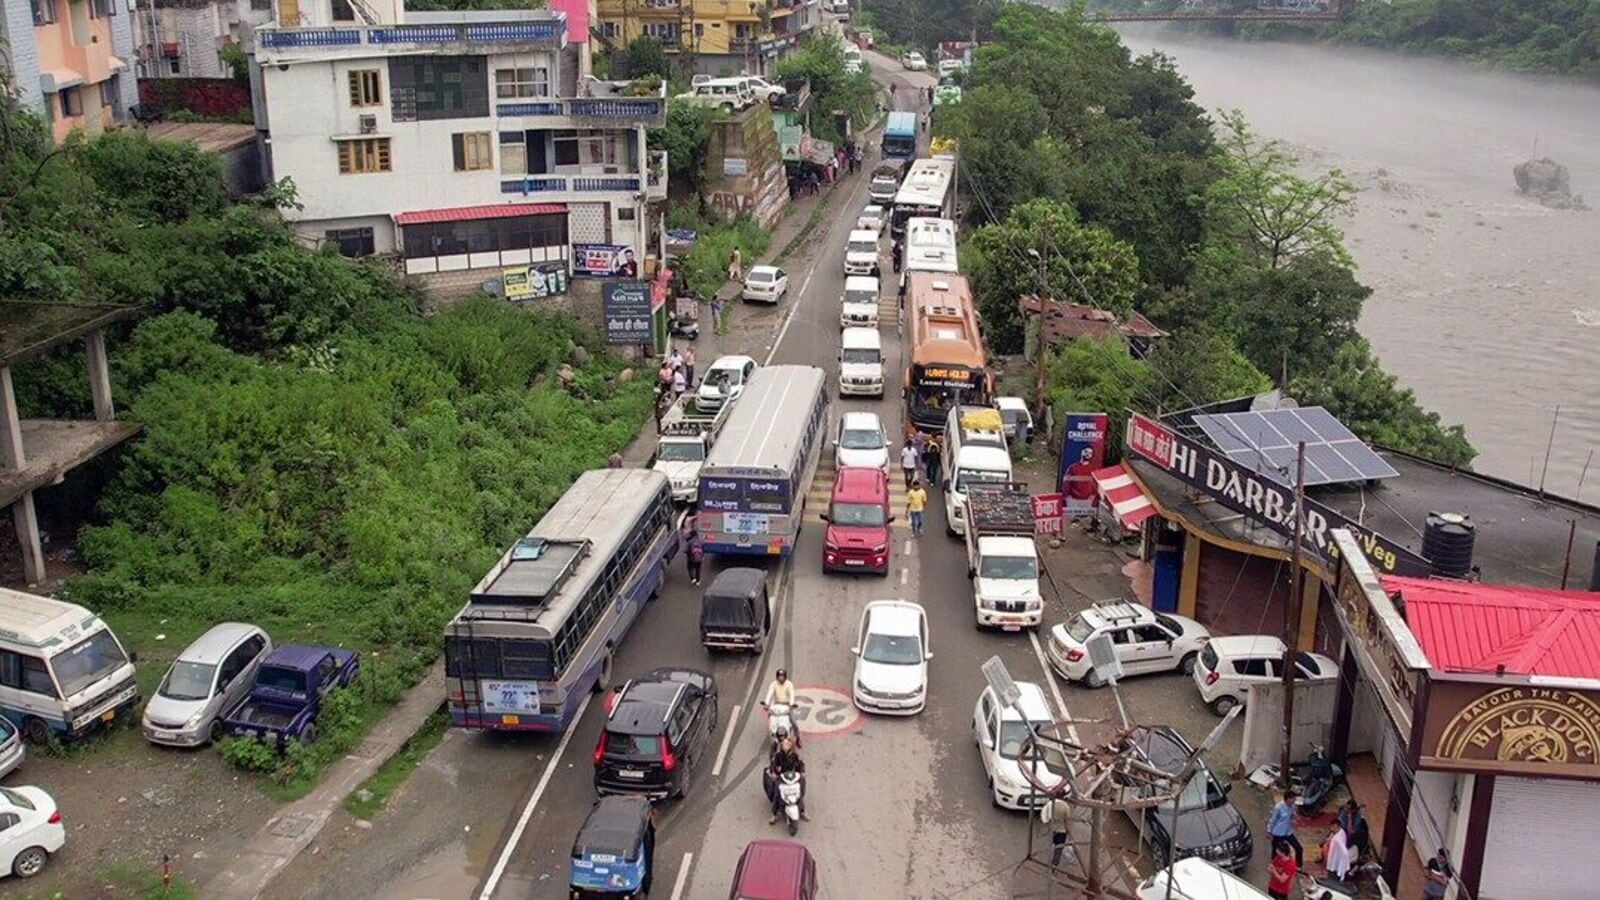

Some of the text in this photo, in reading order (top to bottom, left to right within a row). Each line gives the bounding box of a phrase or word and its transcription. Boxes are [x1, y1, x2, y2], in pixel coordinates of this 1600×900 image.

[1067, 431, 1105, 439] CHALLENGE
[1077, 422, 1097, 431] ROYAL
[1363, 534, 1397, 570] Veg
[1462, 689, 1523, 722] SAVOUR
[1531, 688, 1562, 700] THE
[1470, 708, 1592, 757] BLACK DOG
